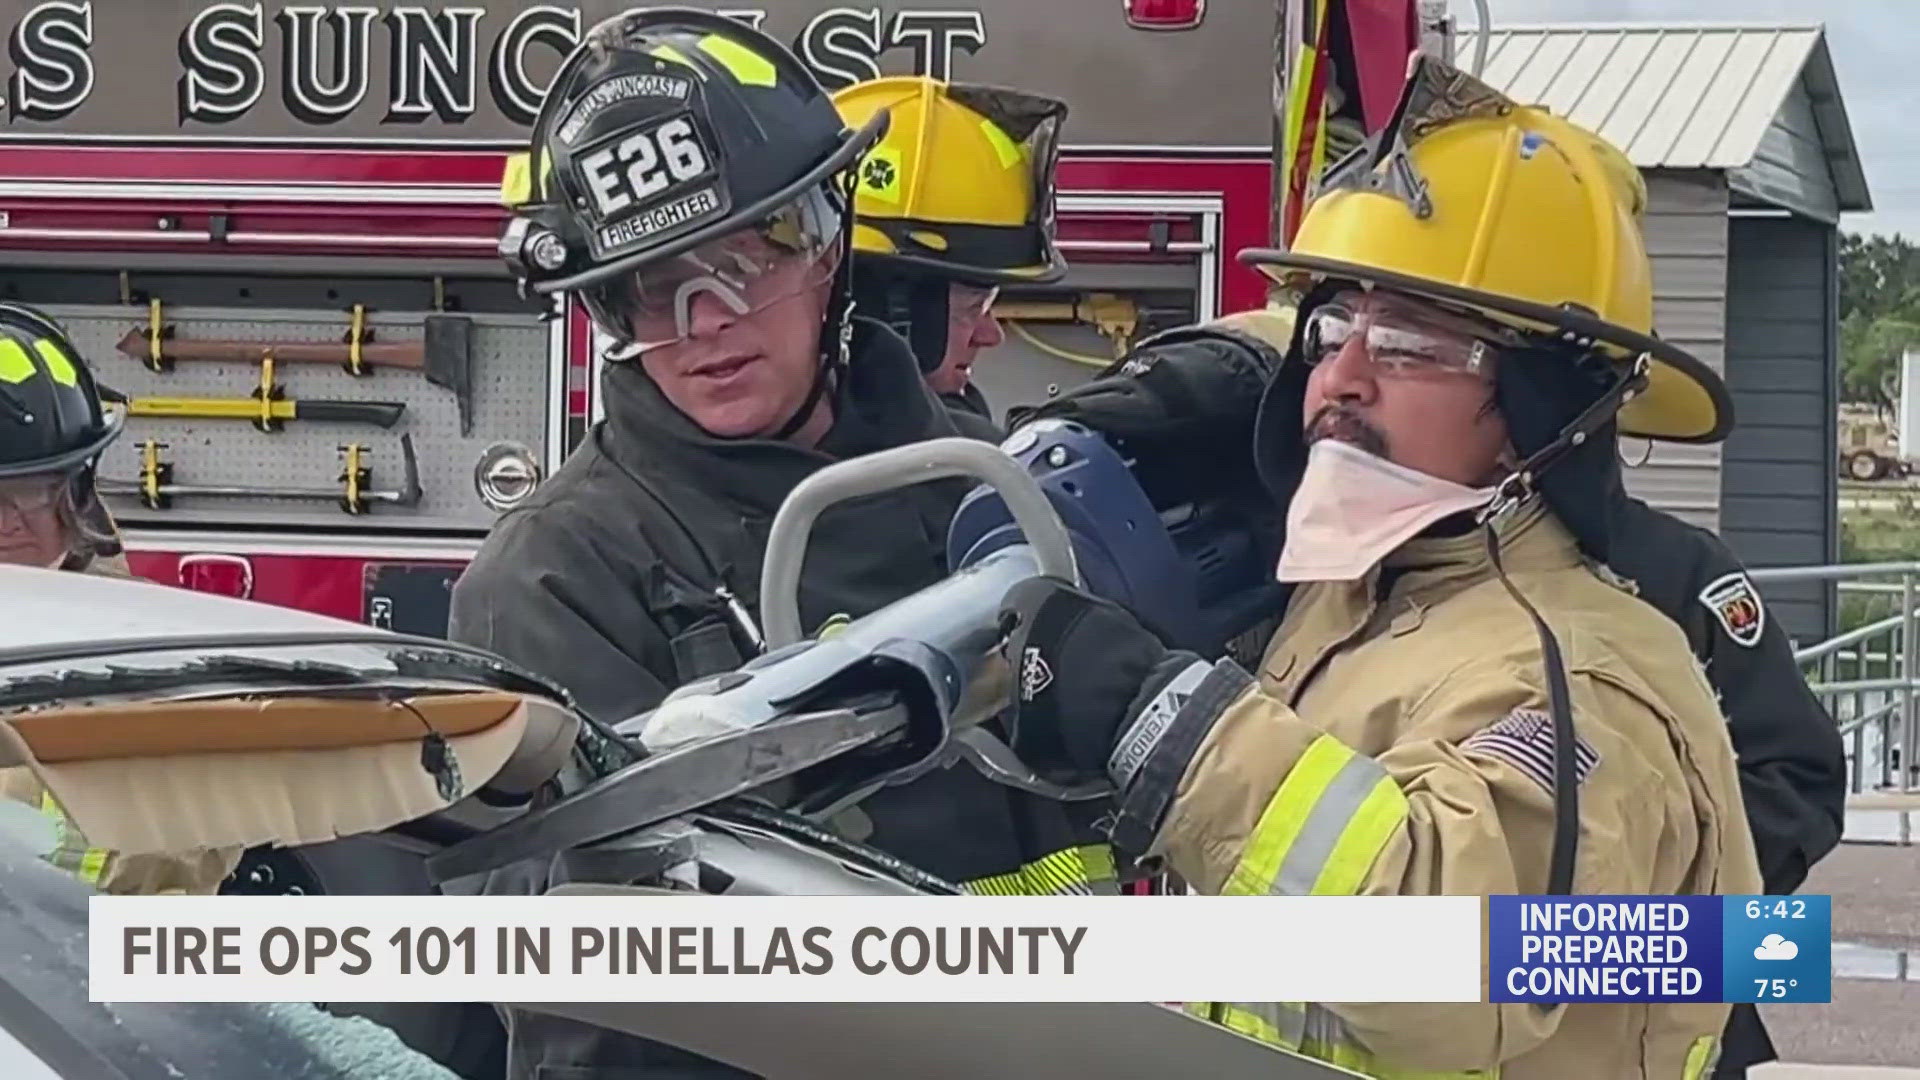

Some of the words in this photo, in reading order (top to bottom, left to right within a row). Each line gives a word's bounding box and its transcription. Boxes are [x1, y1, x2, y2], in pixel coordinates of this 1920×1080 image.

[179, 3, 986, 128] SUNCST
[581, 118, 706, 216] E26
[607, 193, 711, 242] FIREFIGHTER
